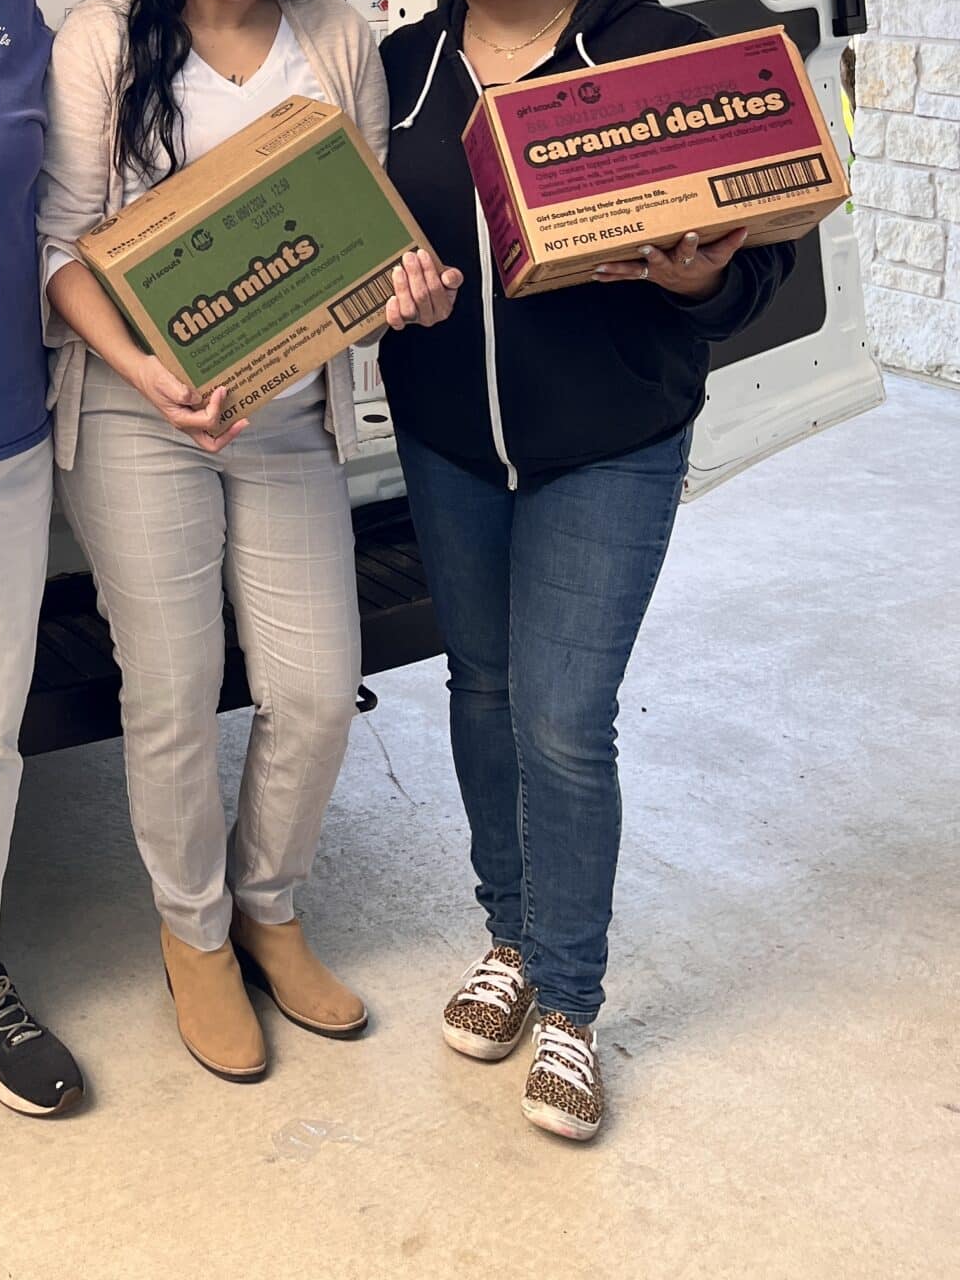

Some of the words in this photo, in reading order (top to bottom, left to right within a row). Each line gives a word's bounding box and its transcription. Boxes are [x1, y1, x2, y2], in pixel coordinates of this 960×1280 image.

[516, 106, 532, 117] girl
[528, 115, 660, 164] caramel
[666, 91, 785, 134] deLites
[536, 214, 550, 222] Girl
[551, 209, 575, 219] Scouts
[576, 204, 596, 214] bring
[597, 200, 614, 208] their
[615, 193, 643, 204] dreams
[653, 188, 667, 196] life.
[552, 218, 577, 228] started
[589, 212, 609, 221] yours
[634, 192, 698, 211] girlscouts.org/join
[544, 237, 570, 252] NOT
[572, 231, 597, 245] FOR
[599, 221, 645, 240] RESALE
[140, 273, 157, 288] girl
[155, 257, 181, 277] scouts
[171, 293, 233, 343] thin
[233, 236, 316, 303] mints
[234, 363, 252, 377] bring
[251, 353, 266, 365] their
[265, 337, 289, 355] dreams
[295, 324, 307, 334] life.
[246, 368, 263, 382] yours
[216, 404, 239, 424] NOT
[237, 389, 261, 409] FOR
[259, 363, 299, 394] RESALE
